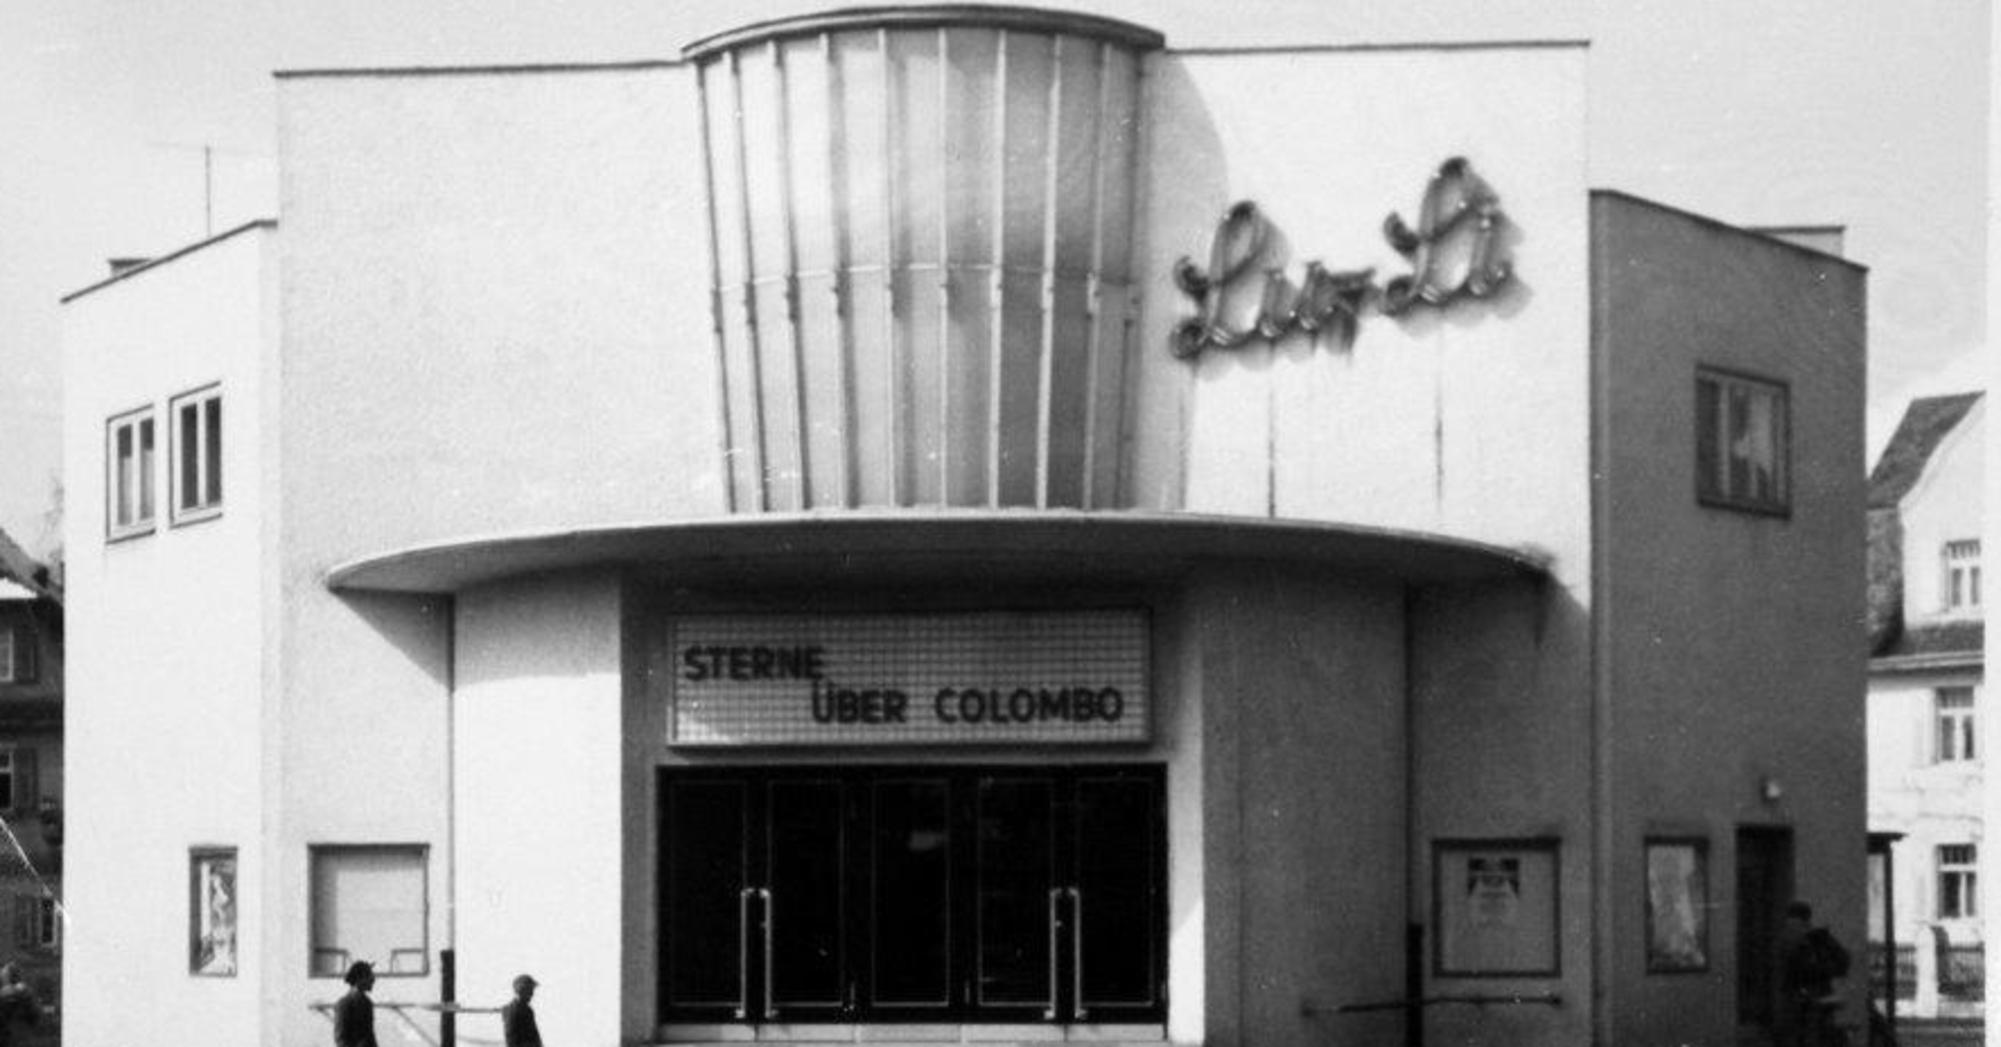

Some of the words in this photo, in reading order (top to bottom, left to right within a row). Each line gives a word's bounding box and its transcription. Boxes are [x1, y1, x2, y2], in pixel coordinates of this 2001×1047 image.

[684, 646, 825, 681] STERNE
[812, 681, 907, 724] ÜBER
[934, 687, 1125, 723] COLOMBO
